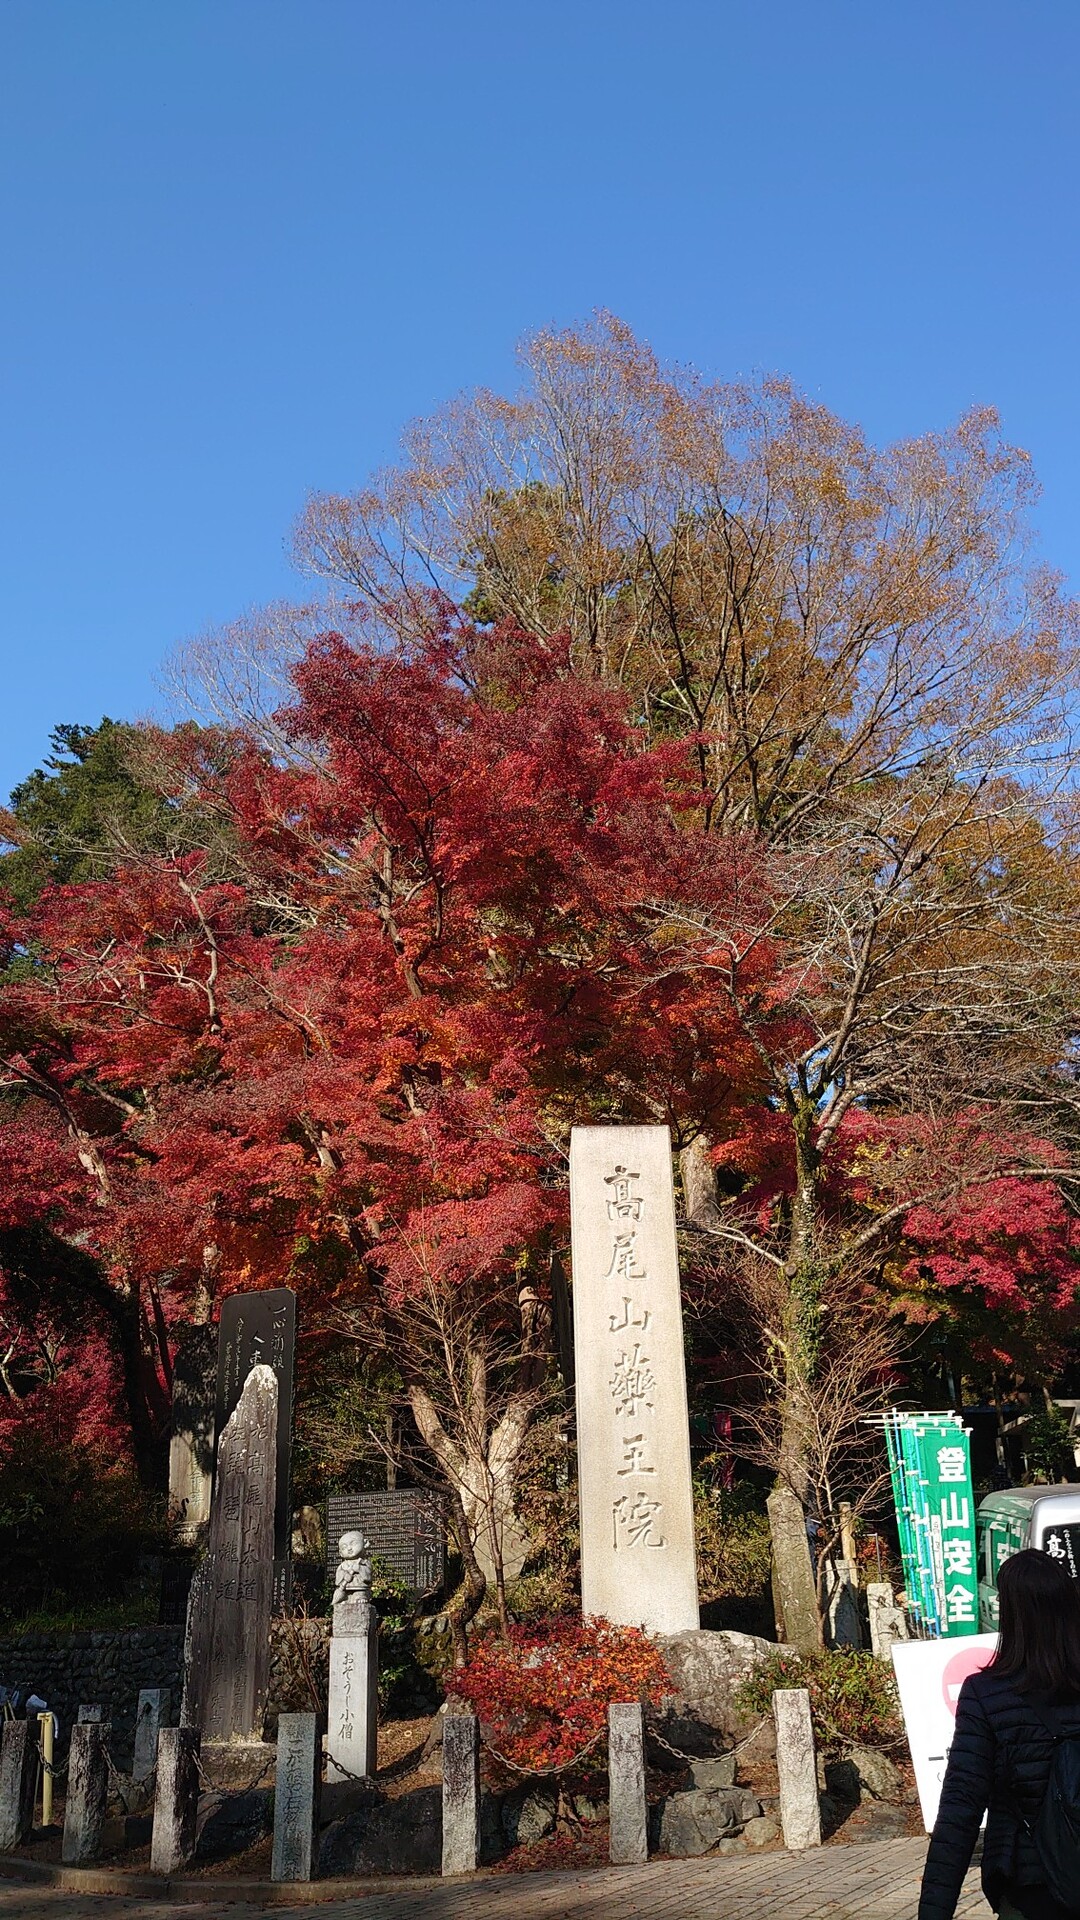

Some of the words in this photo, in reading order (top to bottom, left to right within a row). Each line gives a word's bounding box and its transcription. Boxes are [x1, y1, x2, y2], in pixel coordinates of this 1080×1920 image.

[936, 1446, 976, 1623] 登山安全
[338, 1651, 355, 1741] おそうじ小僧
